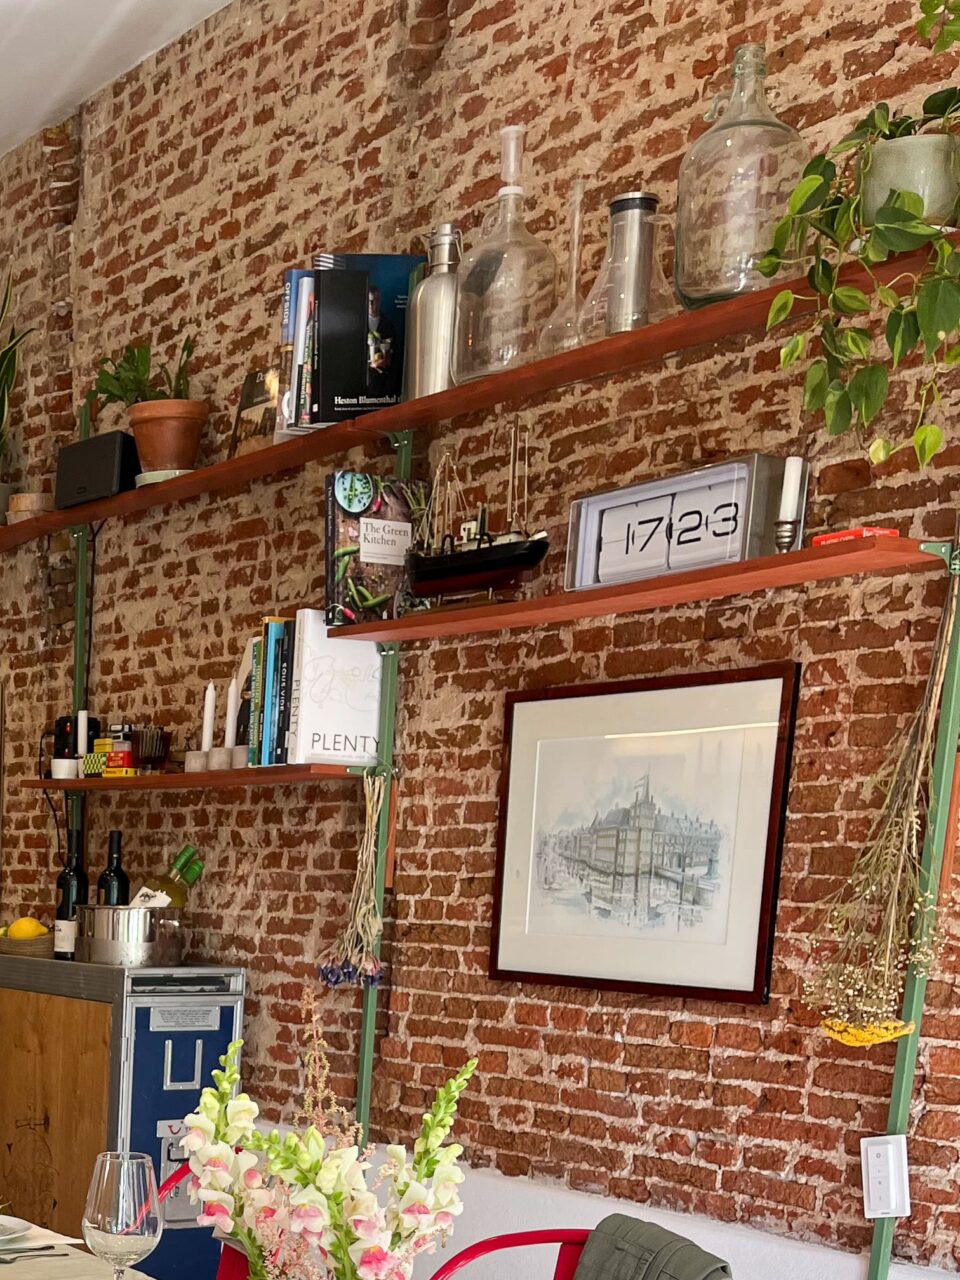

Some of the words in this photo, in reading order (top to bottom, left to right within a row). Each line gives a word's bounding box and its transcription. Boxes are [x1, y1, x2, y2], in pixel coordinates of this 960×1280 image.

[283, 282, 292, 325] OFFSIDE
[334, 396, 358, 405] Heston
[363, 522, 381, 535] The
[382, 524, 409, 537] Green
[363, 534, 397, 547] Kitchen
[290, 679, 301, 737] PLENTY
[312, 732, 380, 753] PLENTY
